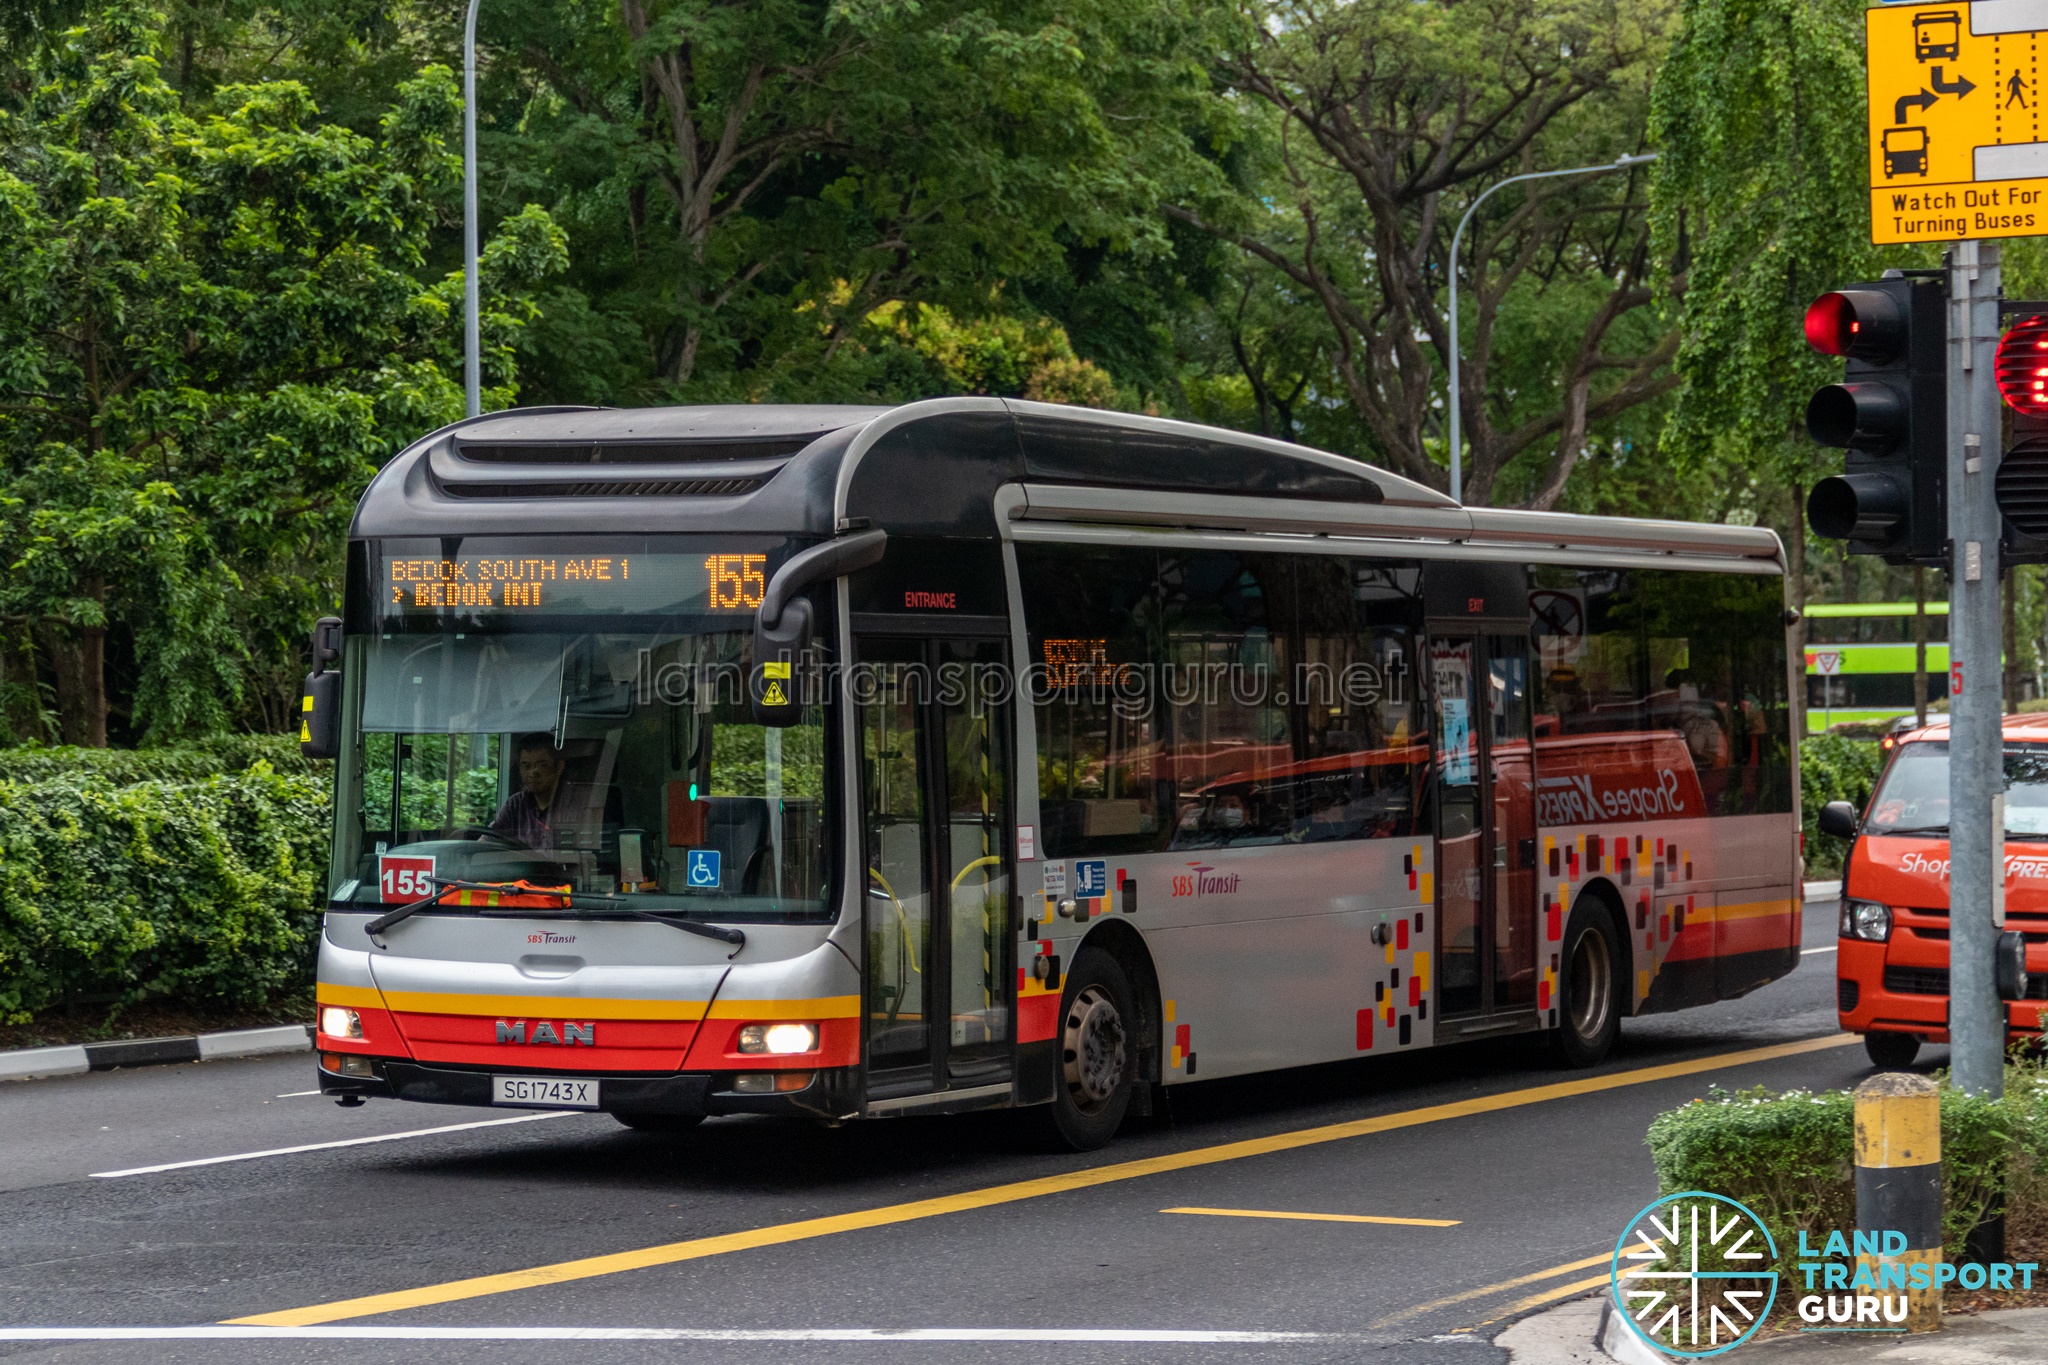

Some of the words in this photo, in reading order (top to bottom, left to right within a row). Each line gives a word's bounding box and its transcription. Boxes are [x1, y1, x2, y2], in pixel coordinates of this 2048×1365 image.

[1892, 192, 1956, 211] Watch
[1965, 189, 2000, 207] Out
[2009, 187, 2042, 205] For
[1893, 214, 1966, 236] Turning
[1975, 212, 2035, 229] Buses
[392, 560, 469, 581] BEDOK
[478, 559, 556, 580] SOUTH
[564, 559, 612, 580] AVE
[621, 558, 629, 580] 1
[705, 554, 767, 608] 155
[415, 582, 493, 606] BEDOK
[504, 582, 543, 606] INT
[905, 591, 956, 609] ENTRANCE
[1951, 661, 1963, 695] 5
[1898, 853, 1950, 880] Shop
[383, 869, 432, 896] 155
[1172, 875, 1193, 897] SBS
[1192, 866, 1241, 898] Transit
[527, 934, 543, 944] SBS
[541, 931, 578, 944] Transit
[495, 1020, 596, 1046] MAN
[504, 1081, 588, 1101] SG1743X
